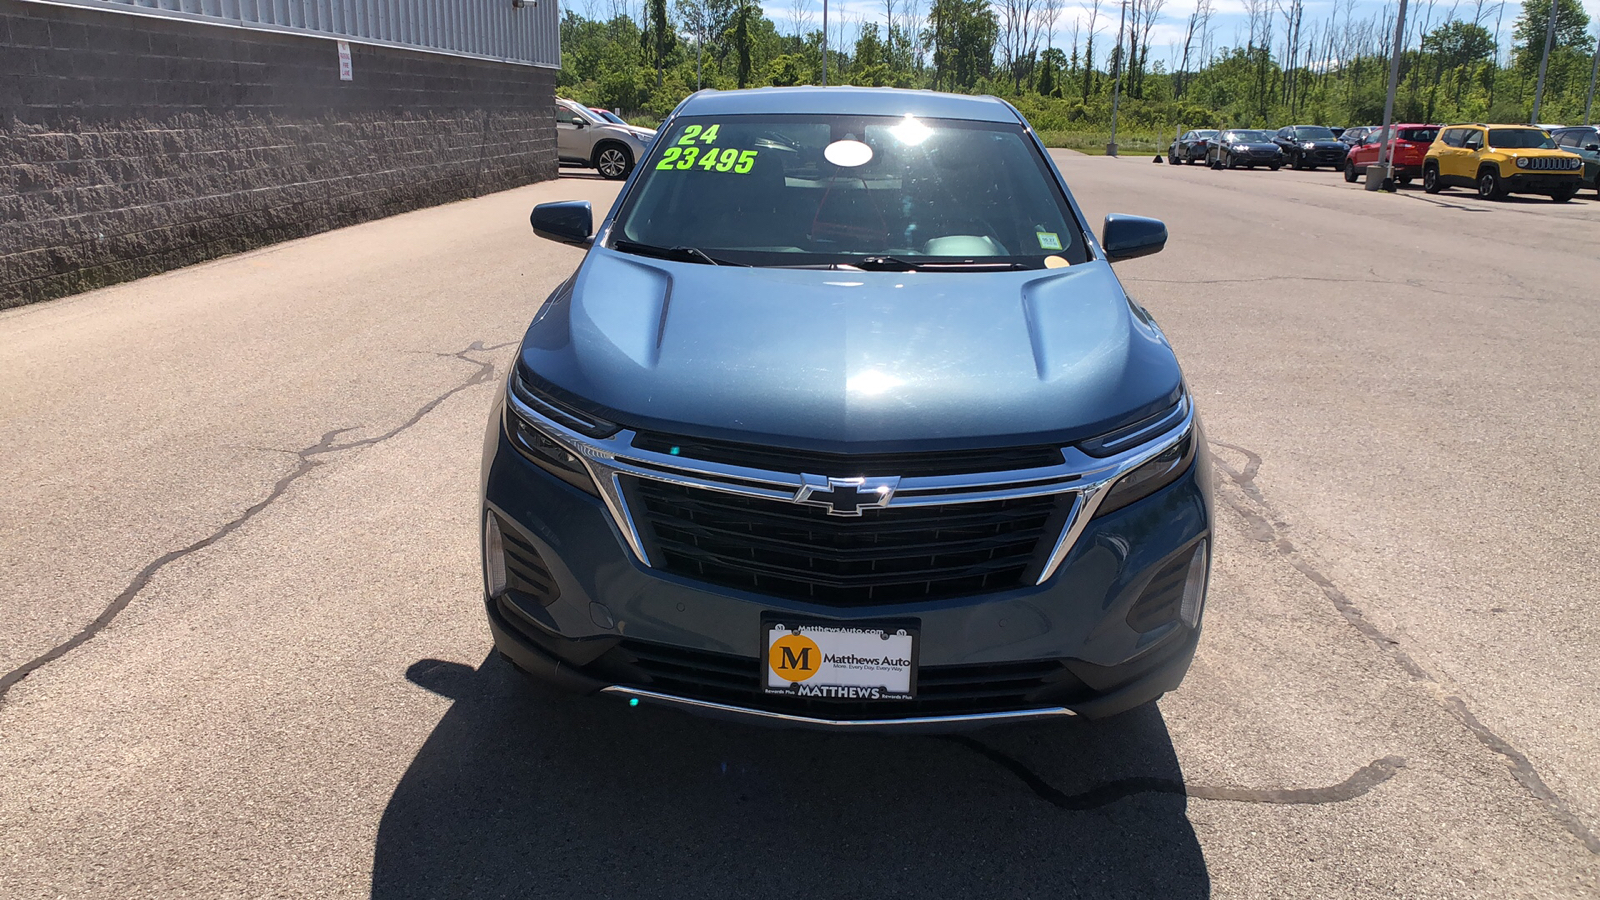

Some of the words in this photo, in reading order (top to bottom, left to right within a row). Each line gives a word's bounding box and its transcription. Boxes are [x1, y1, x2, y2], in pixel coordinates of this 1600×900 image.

[677, 124, 721, 146] 24
[798, 625, 884, 635] MatthewsAuto.com
[778, 646, 812, 671] M
[823, 653, 880, 666] Matthews
[881, 655, 911, 667] Auto
[797, 685, 881, 699] MATTHEWS
